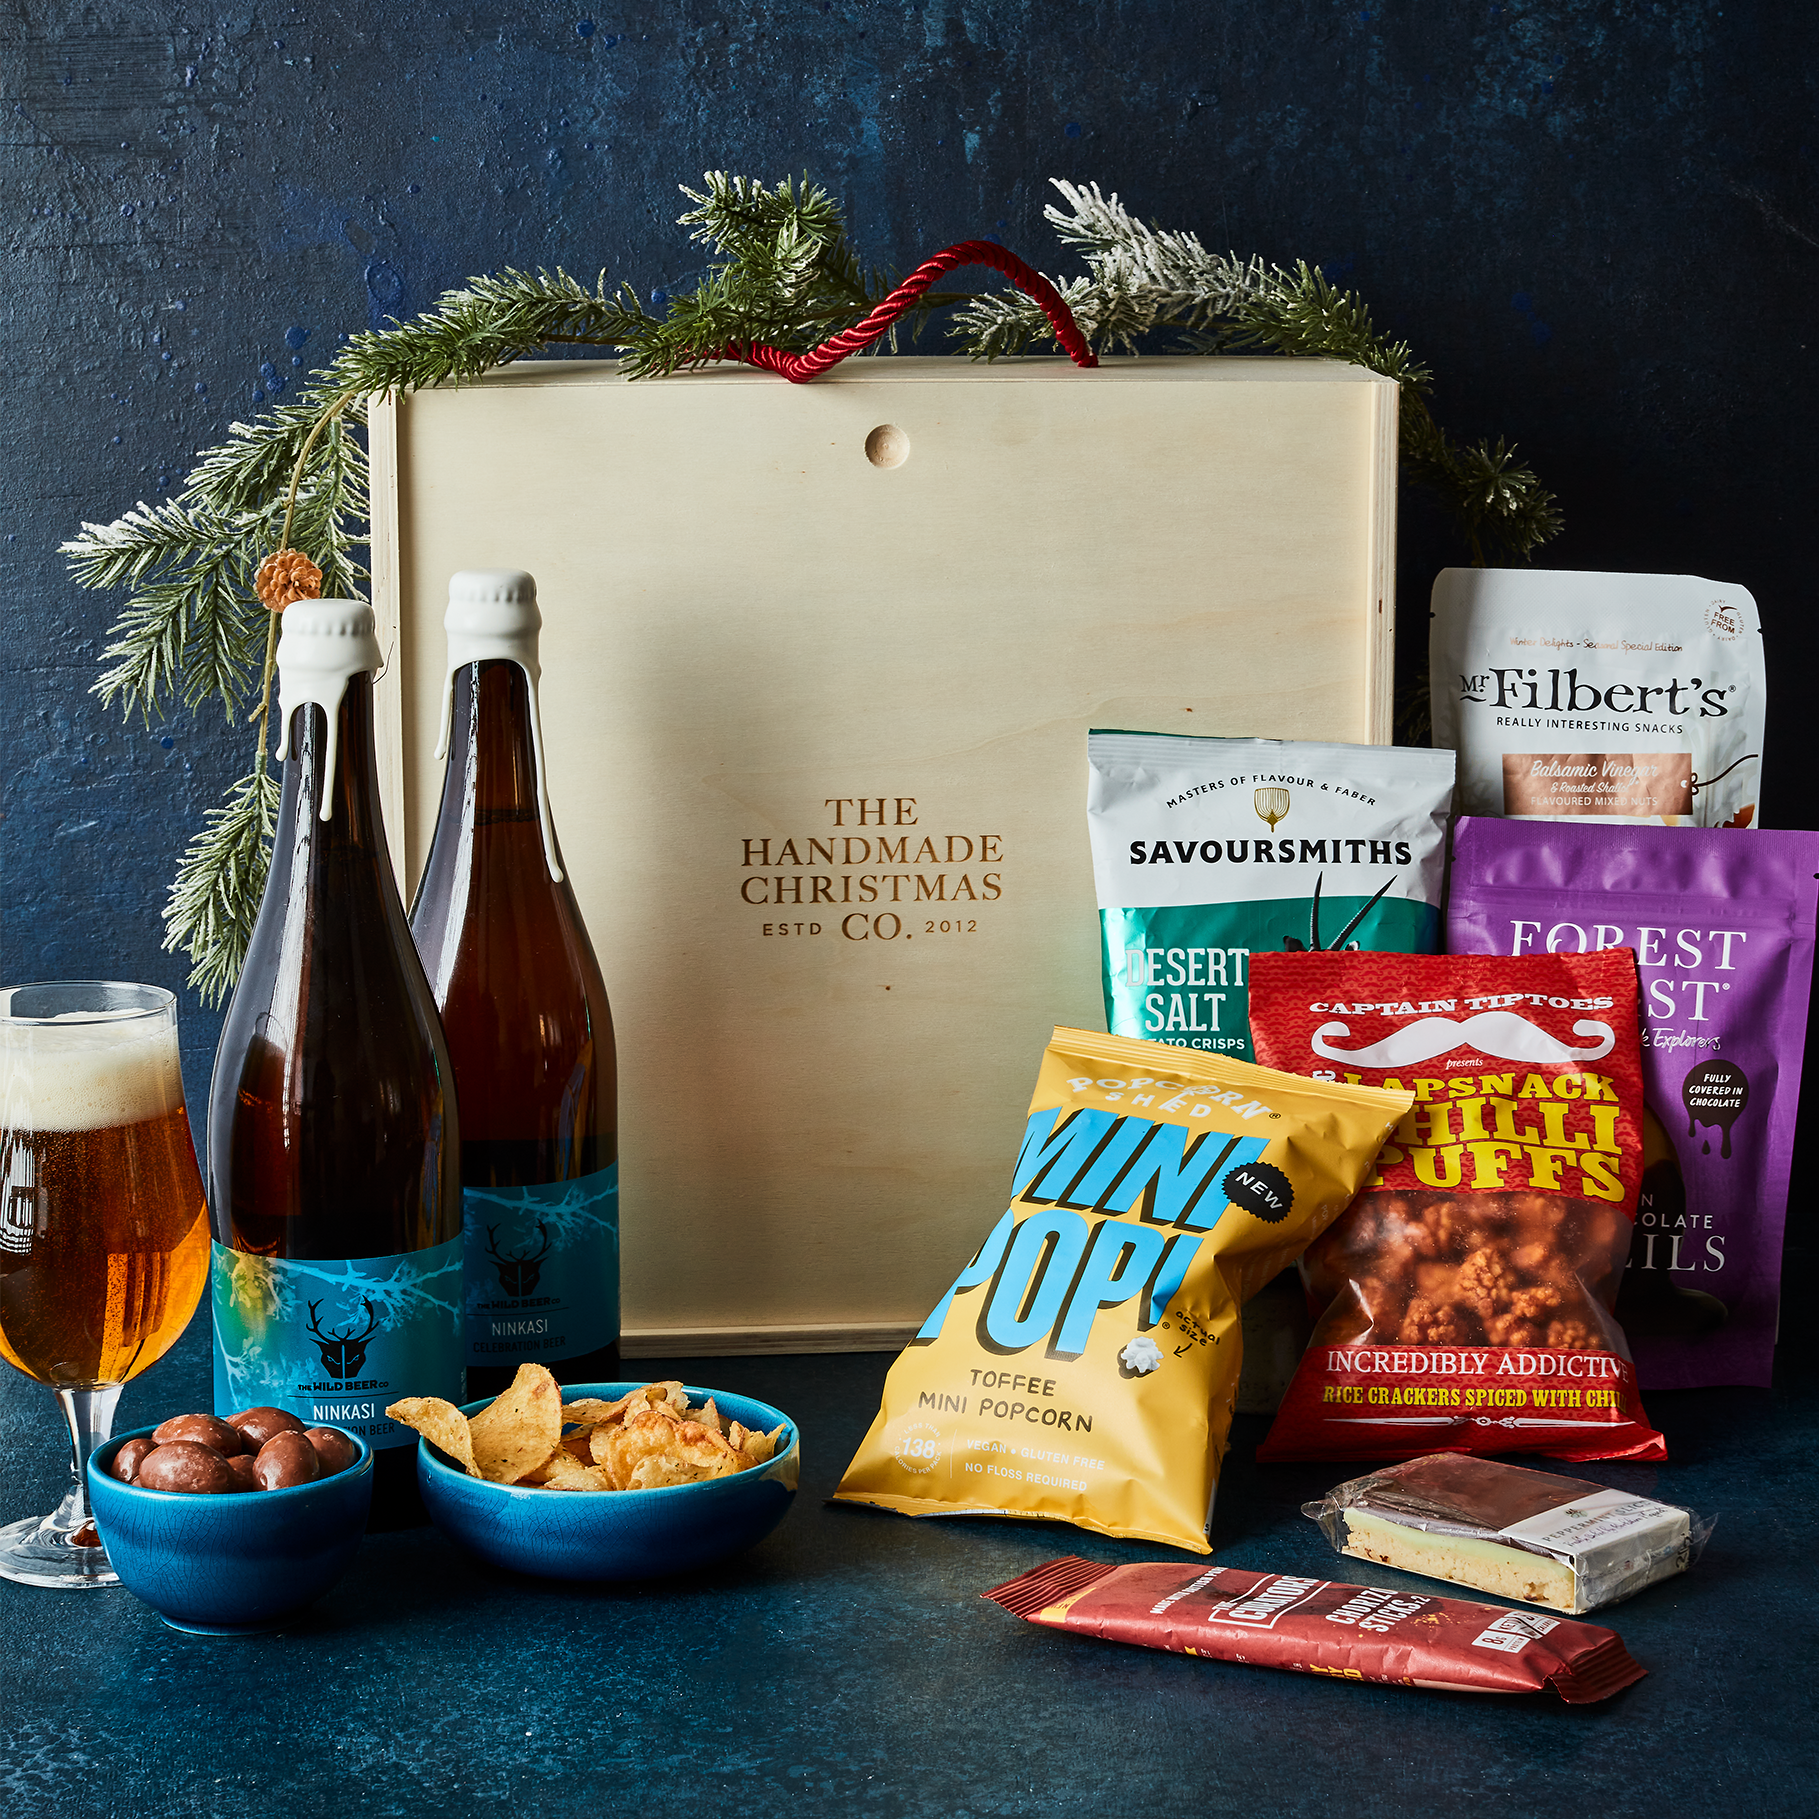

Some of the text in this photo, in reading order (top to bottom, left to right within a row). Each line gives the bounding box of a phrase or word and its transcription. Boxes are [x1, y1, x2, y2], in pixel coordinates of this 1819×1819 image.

[1711, 618, 1736, 634] FROM
[1714, 611, 1735, 627] FREE
[1509, 636, 1684, 655] Winter Delights Seasonal Special Edition
[1489, 667, 1729, 717] Filbert's
[1496, 716, 1684, 735] REALLY INTERESTING SNACKS
[1530, 760, 1659, 785] Balsamic Vinegar
[1166, 773, 1377, 809] MASTERS OF FLAVOUR & FABER
[1550, 782, 1558, 793] &
[1559, 781, 1595, 793] Roasted
[824, 797, 919, 827] THE
[1530, 796, 1658, 806] FLAVOURED MIXED NUTS
[741, 834, 1004, 867] HANDMADE
[1129, 838, 1413, 866] SAVOURSMITHS
[740, 872, 1003, 905] CHRISTMAS
[762, 912, 978, 941] ESTD CO. 2012
[1509, 919, 1747, 970] FOREST
[1125, 947, 1250, 988] DESERT
[1144, 993, 1227, 1032] SALT
[1309, 992, 1615, 1017] CAPTAIN TIPTOES
[1191, 1038, 1246, 1050] CRISPS
[1652, 1027, 1721, 1053] Explorers
[1445, 1056, 1484, 1071] presents
[1688, 1085, 1744, 1096] COVERED IN
[1703, 1073, 1732, 1083] FULLY
[1066, 1077, 1274, 1121] POPCORN
[1105, 1091, 1212, 1118] SHED
[1689, 1097, 1741, 1108] CHOCOLATE
[1394, 1096, 1624, 1156] HILLI
[1010, 1105, 1271, 1234] MINI
[1235, 1171, 1284, 1211] NEW
[491, 1300, 520, 1310] WILD
[521, 1297, 551, 1308] BEER
[492, 1318, 548, 1336] NINKASI
[1175, 1310, 1221, 1346] actual
[1179, 1323, 1208, 1347] size
[473, 1335, 567, 1353] CELEBRATION BEER
[1325, 1350, 1489, 1376] INCREDIBLY
[298, 1384, 312, 1392] THE
[312, 1381, 343, 1392] WILD
[345, 1379, 378, 1391] BEER
[969, 1368, 1057, 1398] TOFFEE
[1323, 1386, 1364, 1404] RICE
[1367, 1386, 1461, 1407] CRACKERS
[1464, 1387, 1528, 1408] SPICED
[1531, 1388, 1583, 1408] WITH
[313, 1402, 375, 1421] NINKASI
[917, 1391, 1094, 1433] MINI POPCORN
[369, 1422, 396, 1436] BEER
[903, 1422, 941, 1438] LESS THAN
[894, 1445, 942, 1475] CALORIES PER PACK
[902, 1437, 936, 1460] 138
[966, 1438, 1106, 1471] VEGAN GLUTEN FREE
[965, 1462, 1088, 1492] NO FLOSS REQUIRED
[1541, 1511, 1617, 1543] PEPPERMINT
